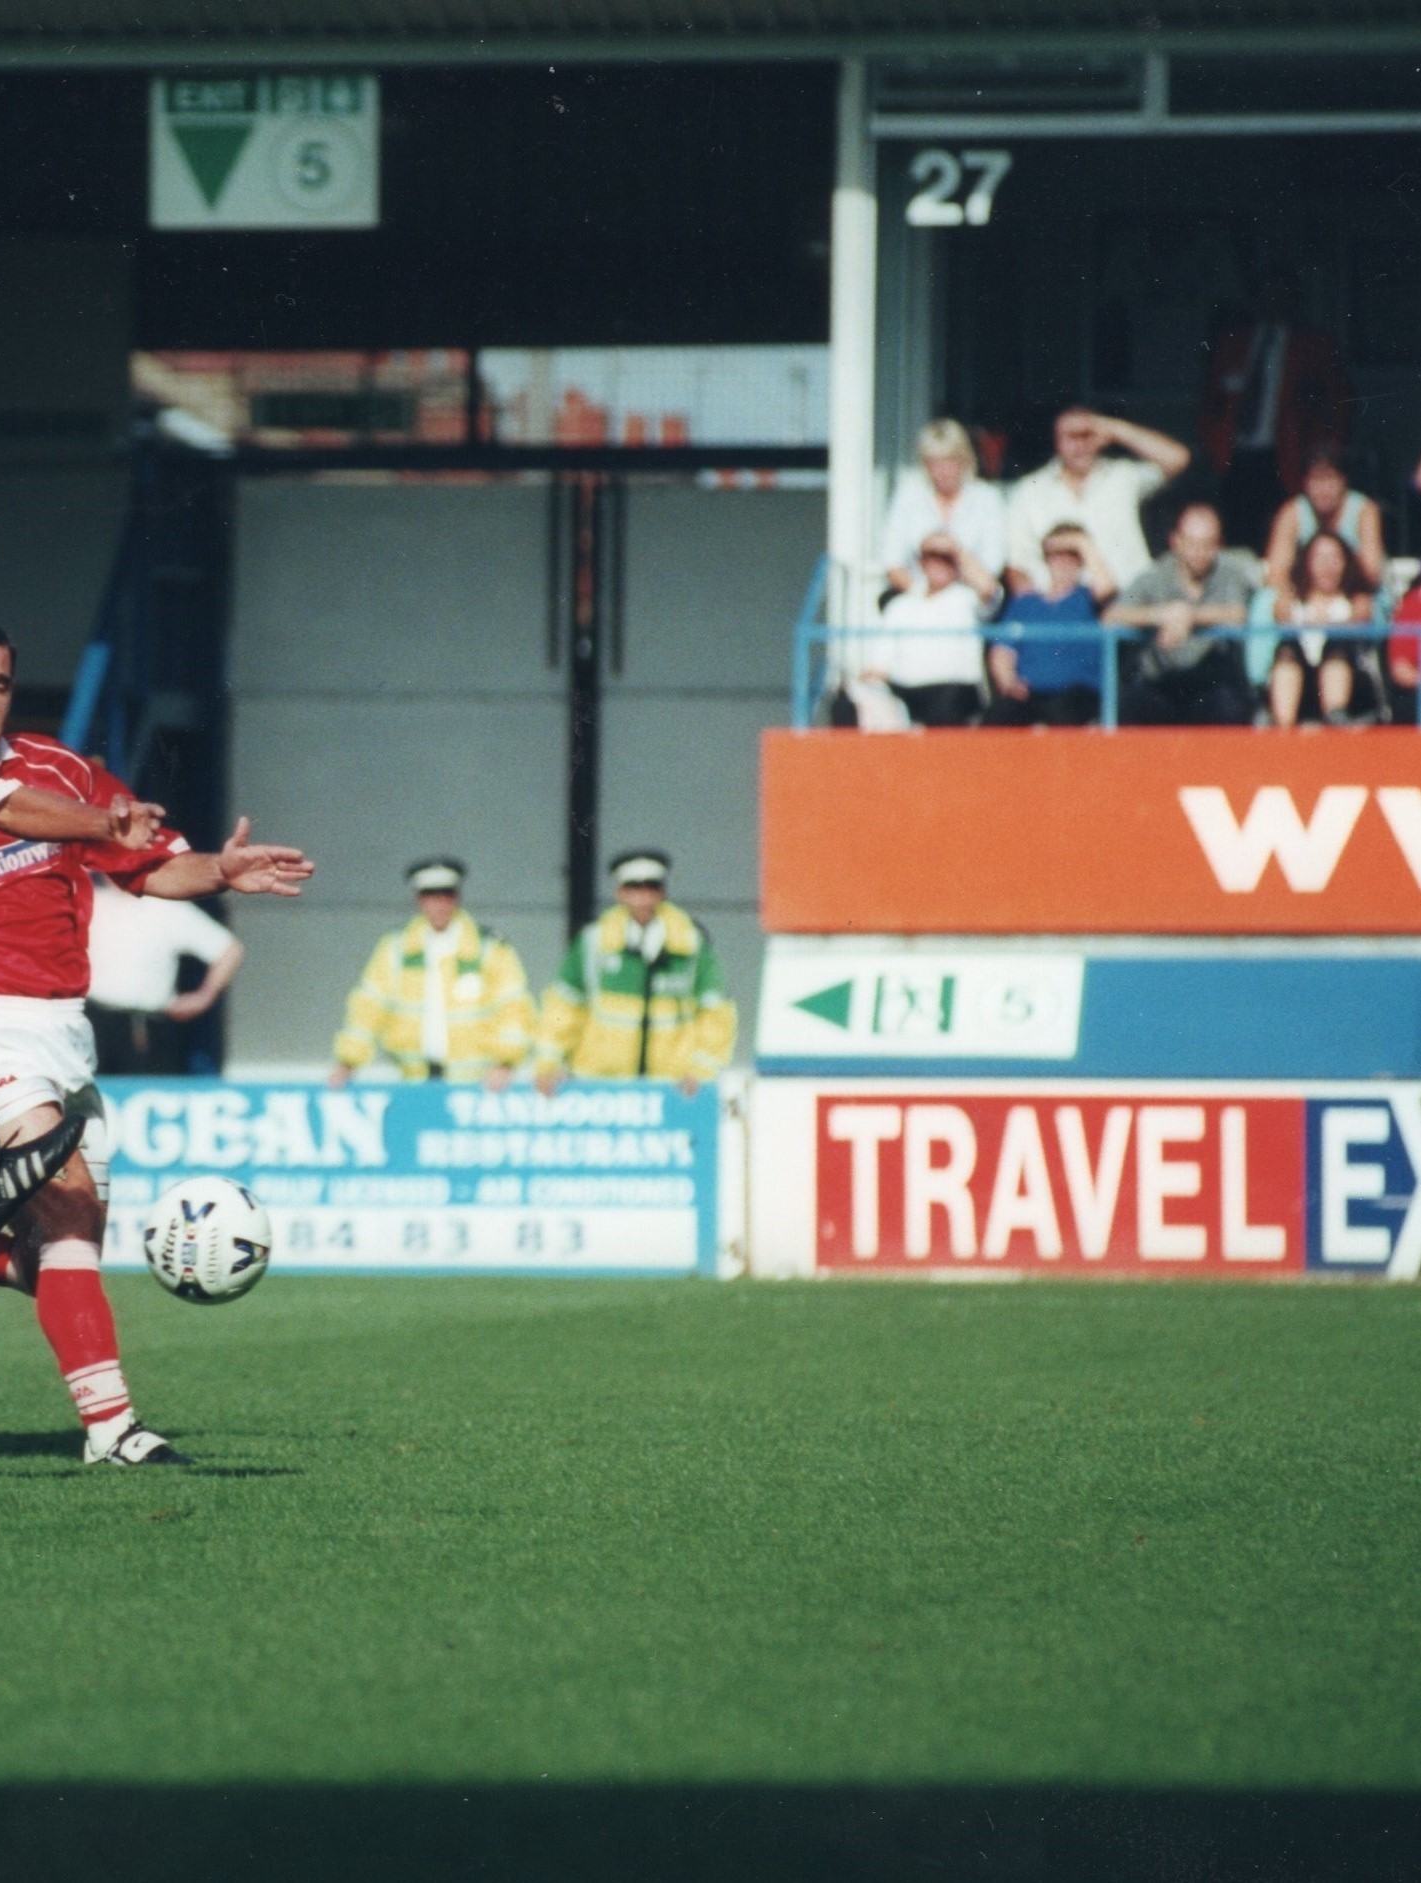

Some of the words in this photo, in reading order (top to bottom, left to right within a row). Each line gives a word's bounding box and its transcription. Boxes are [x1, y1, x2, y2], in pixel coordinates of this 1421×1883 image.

[296, 140, 332, 192] 5
[906, 149, 1012, 226] 27
[1001, 984, 1034, 1024] 5
[104, 1090, 391, 1168] CEAN
[417, 1129, 695, 1168] RESTAURANT
[826, 1103, 1287, 1262] TRAVEL
